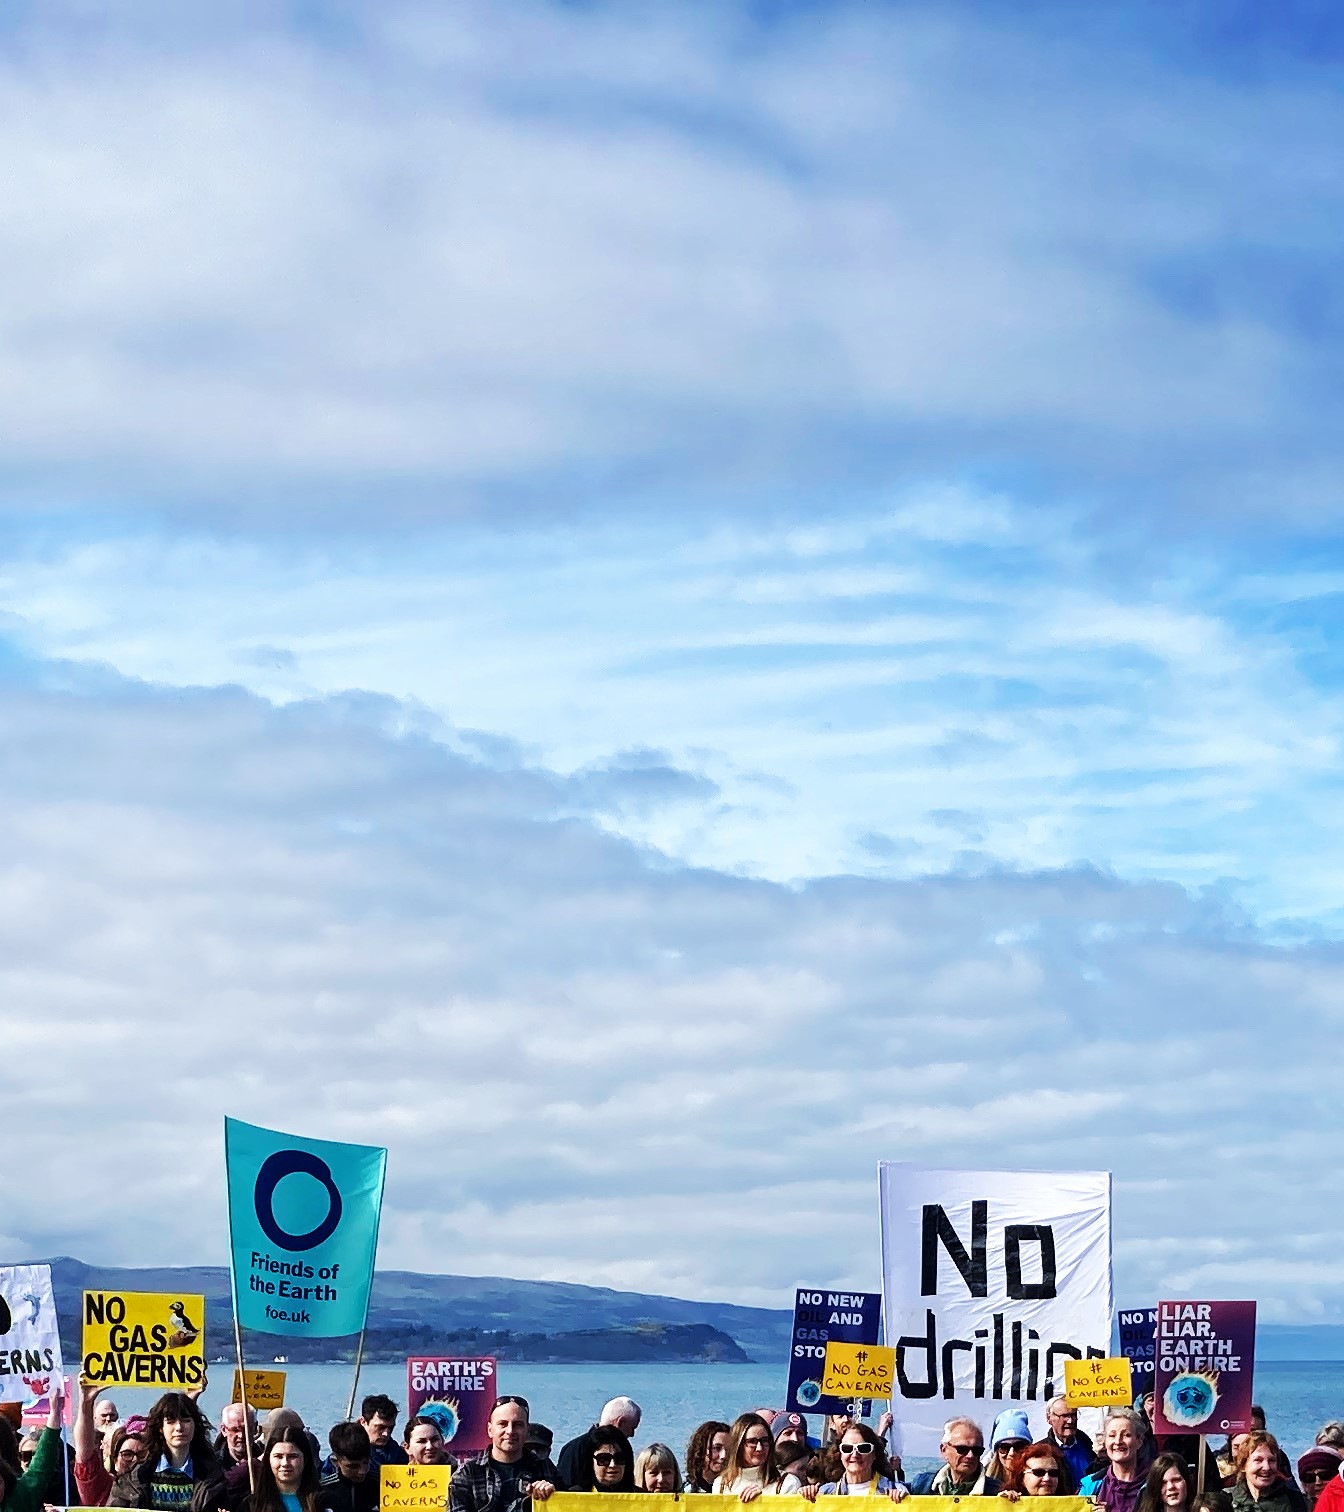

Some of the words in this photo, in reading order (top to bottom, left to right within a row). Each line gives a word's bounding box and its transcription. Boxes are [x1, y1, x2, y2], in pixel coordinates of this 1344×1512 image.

[921, 1200, 1057, 1300] No
[251, 1251, 314, 1279] Friends
[318, 1264, 340, 1279] of
[249, 1274, 275, 1294] the
[278, 1280, 337, 1301] Earth
[799, 1292, 823, 1305] NO
[827, 1294, 865, 1308] NEW
[86, 1293, 126, 1326] NO
[265, 1305, 311, 1323] foe.uk
[1161, 1304, 1212, 1321] LIAR
[828, 1312, 863, 1325] AND
[1121, 1312, 1144, 1325] NO
[110, 1324, 168, 1353] GAS
[796, 1328, 829, 1340] GAS
[1160, 1321, 1216, 1340] LIAR,
[895, 1309, 1106, 1401] drillin
[1123, 1344, 1155, 1357] GAS
[1160, 1339, 1233, 1356] EARTH
[83, 1352, 204, 1384] CAVERNS
[411, 1361, 494, 1376] EARTH'S
[832, 1363, 851, 1375] NO
[857, 1364, 888, 1377] GAS
[1160, 1356, 1190, 1372] ON
[1194, 1356, 1242, 1372] FIRE
[412, 1377, 443, 1392] ON
[444, 1376, 486, 1391] FIRE
[825, 1378, 892, 1393] CAVERNS
[1072, 1377, 1089, 1387] NO
[1096, 1374, 1123, 1385] GAS
[235, 1392, 281, 1400] CVERNS
[1069, 1386, 1128, 1399] CAVERNS
[385, 1479, 401, 1489] NO
[409, 1479, 438, 1489] GAS
[382, 1495, 448, 1508] CAVERNS
